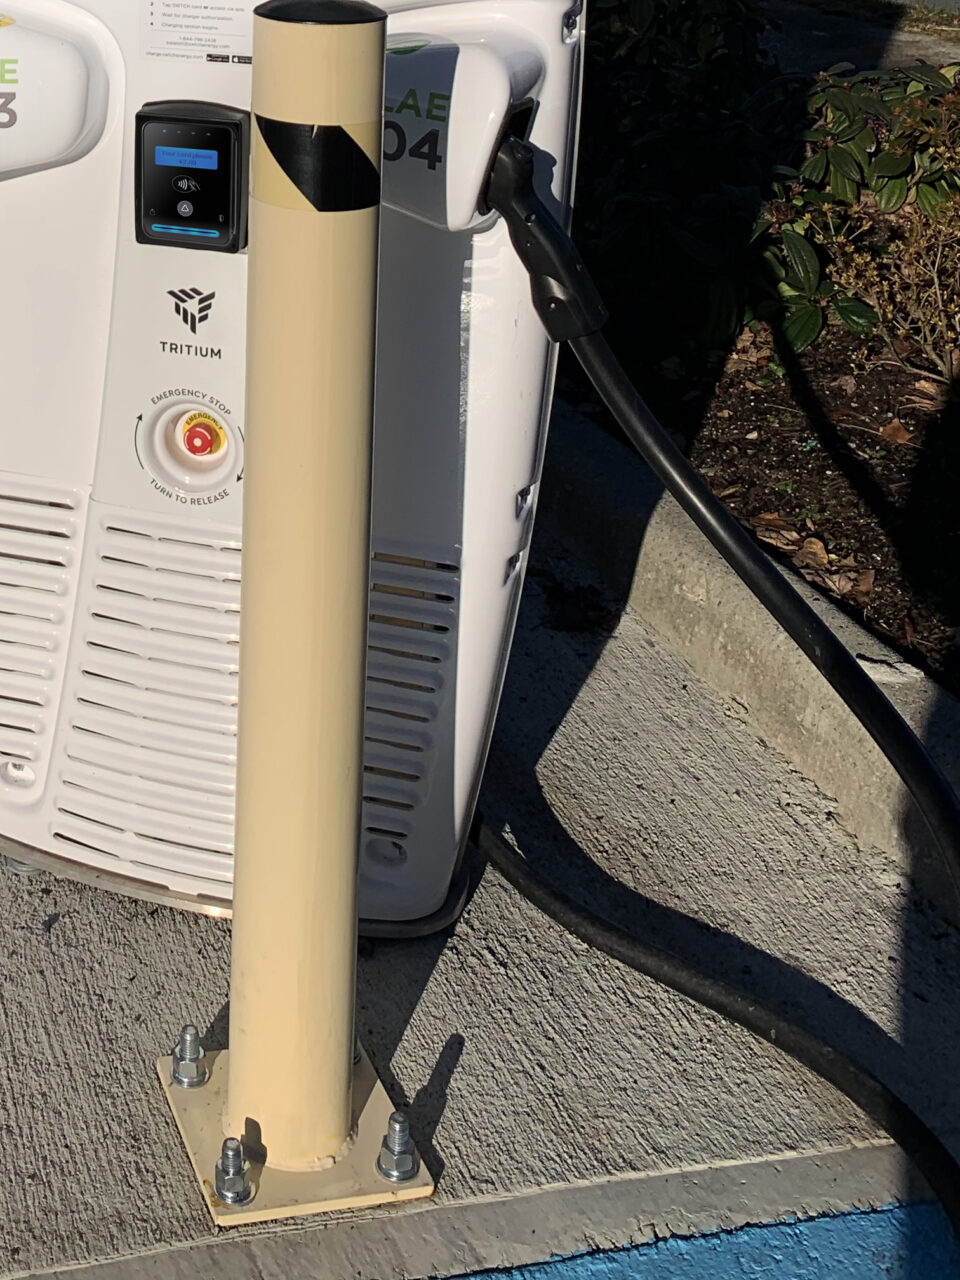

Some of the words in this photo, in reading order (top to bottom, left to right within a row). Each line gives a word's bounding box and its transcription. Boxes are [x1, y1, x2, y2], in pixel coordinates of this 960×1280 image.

[383, 88, 451, 123] AE
[383, 120, 443, 171] 04
[159, 341, 222, 360] TRITIUM
[150, 388, 208, 405] EMERGENCY
[208, 396, 232, 416] STOP
[185, 412, 224, 430] EMERGENCY
[150, 478, 174, 499] TURN
[175, 494, 188, 504] TO
[190, 488, 230, 506] RELEASE
